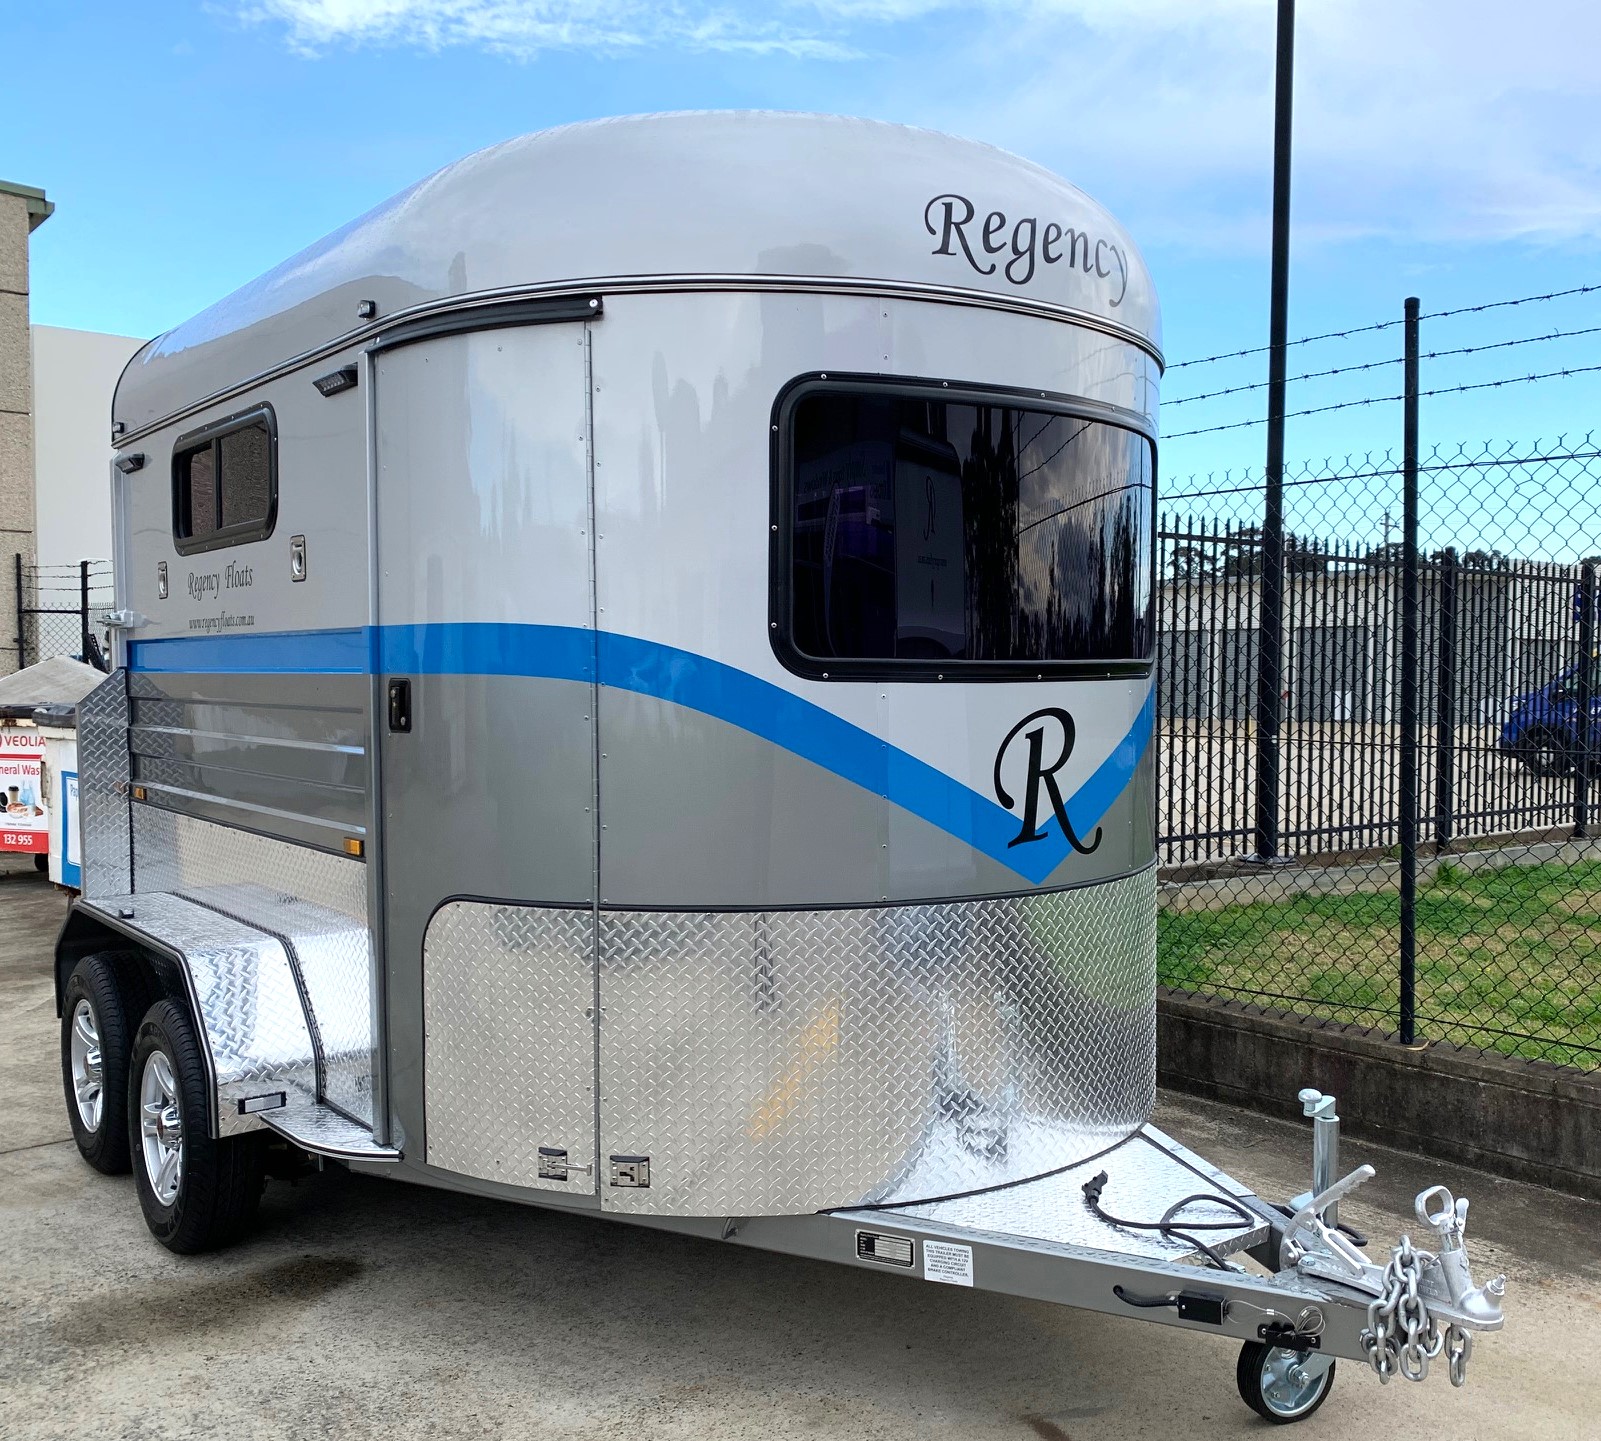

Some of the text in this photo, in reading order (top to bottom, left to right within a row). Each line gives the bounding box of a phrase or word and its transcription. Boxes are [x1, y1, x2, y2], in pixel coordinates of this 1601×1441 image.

[924, 193, 1128, 308] Regency
[187, 560, 253, 601] Regency Floats
[188, 610, 255, 634] www.regencyfloats.com.au
[4, 735, 46, 747] VEOLIA
[993, 707, 1103, 855] R
[3, 834, 33, 846] 132 955
